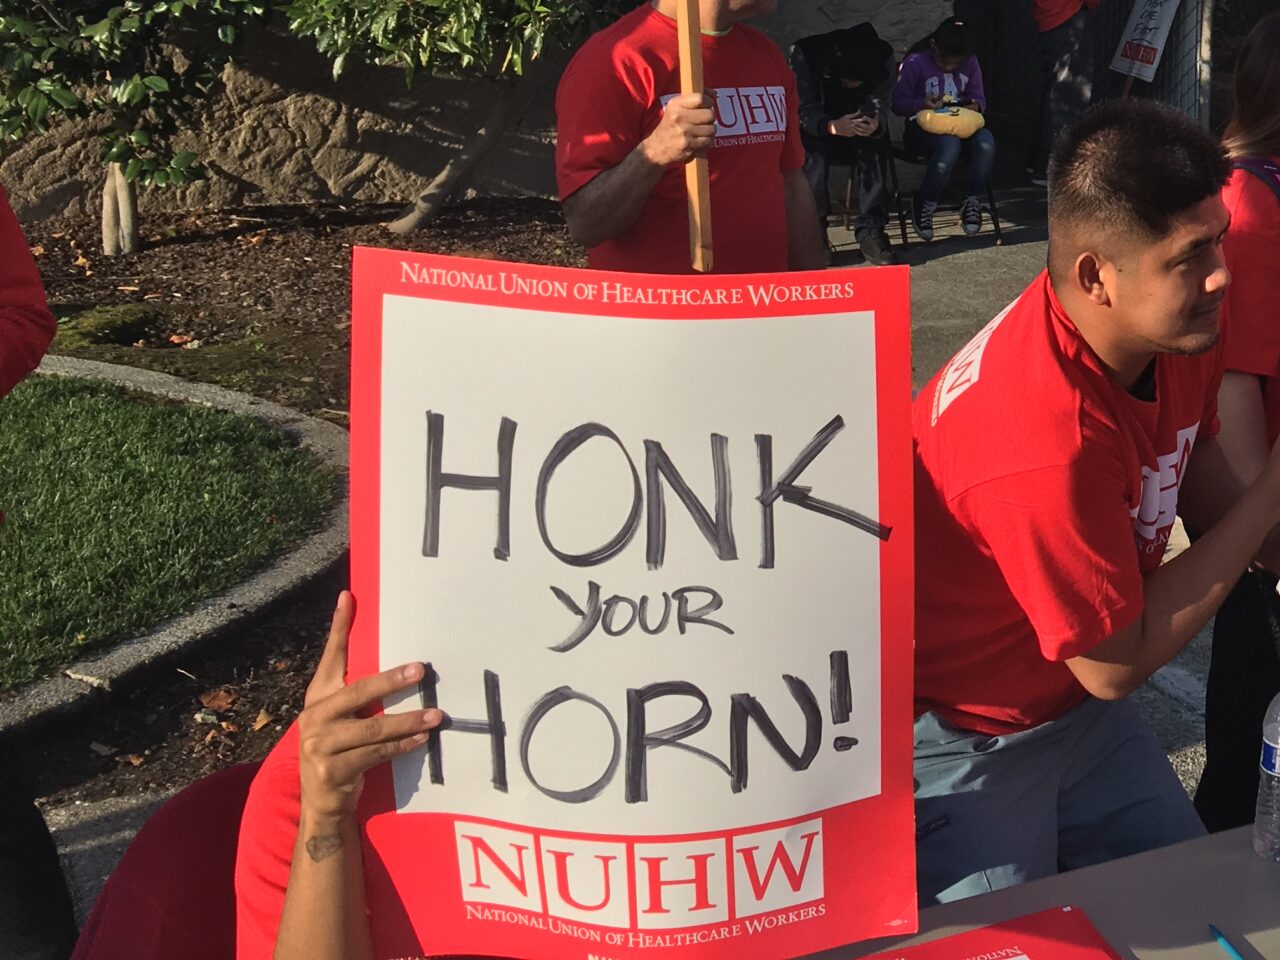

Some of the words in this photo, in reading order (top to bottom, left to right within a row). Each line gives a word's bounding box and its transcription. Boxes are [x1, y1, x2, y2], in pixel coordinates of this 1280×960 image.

[713, 93, 786, 128] UHW
[400, 261, 498, 293] NATIONAL
[499, 271, 567, 300] UNION
[573, 283, 599, 300] OF
[600, 283, 743, 306] HEALTHCARE
[747, 281, 855, 307] WORKERS
[422, 409, 893, 570] HONK
[547, 580, 736, 652] YOUR
[417, 650, 859, 804] HORN!
[460, 831, 821, 915] NUHW
[465, 904, 547, 931] NATIONAL
[548, 920, 602, 942] UNION
[605, 931, 625, 946] OF
[626, 925, 742, 947] HEALTHCARE
[743, 903, 827, 935] WORKERS
